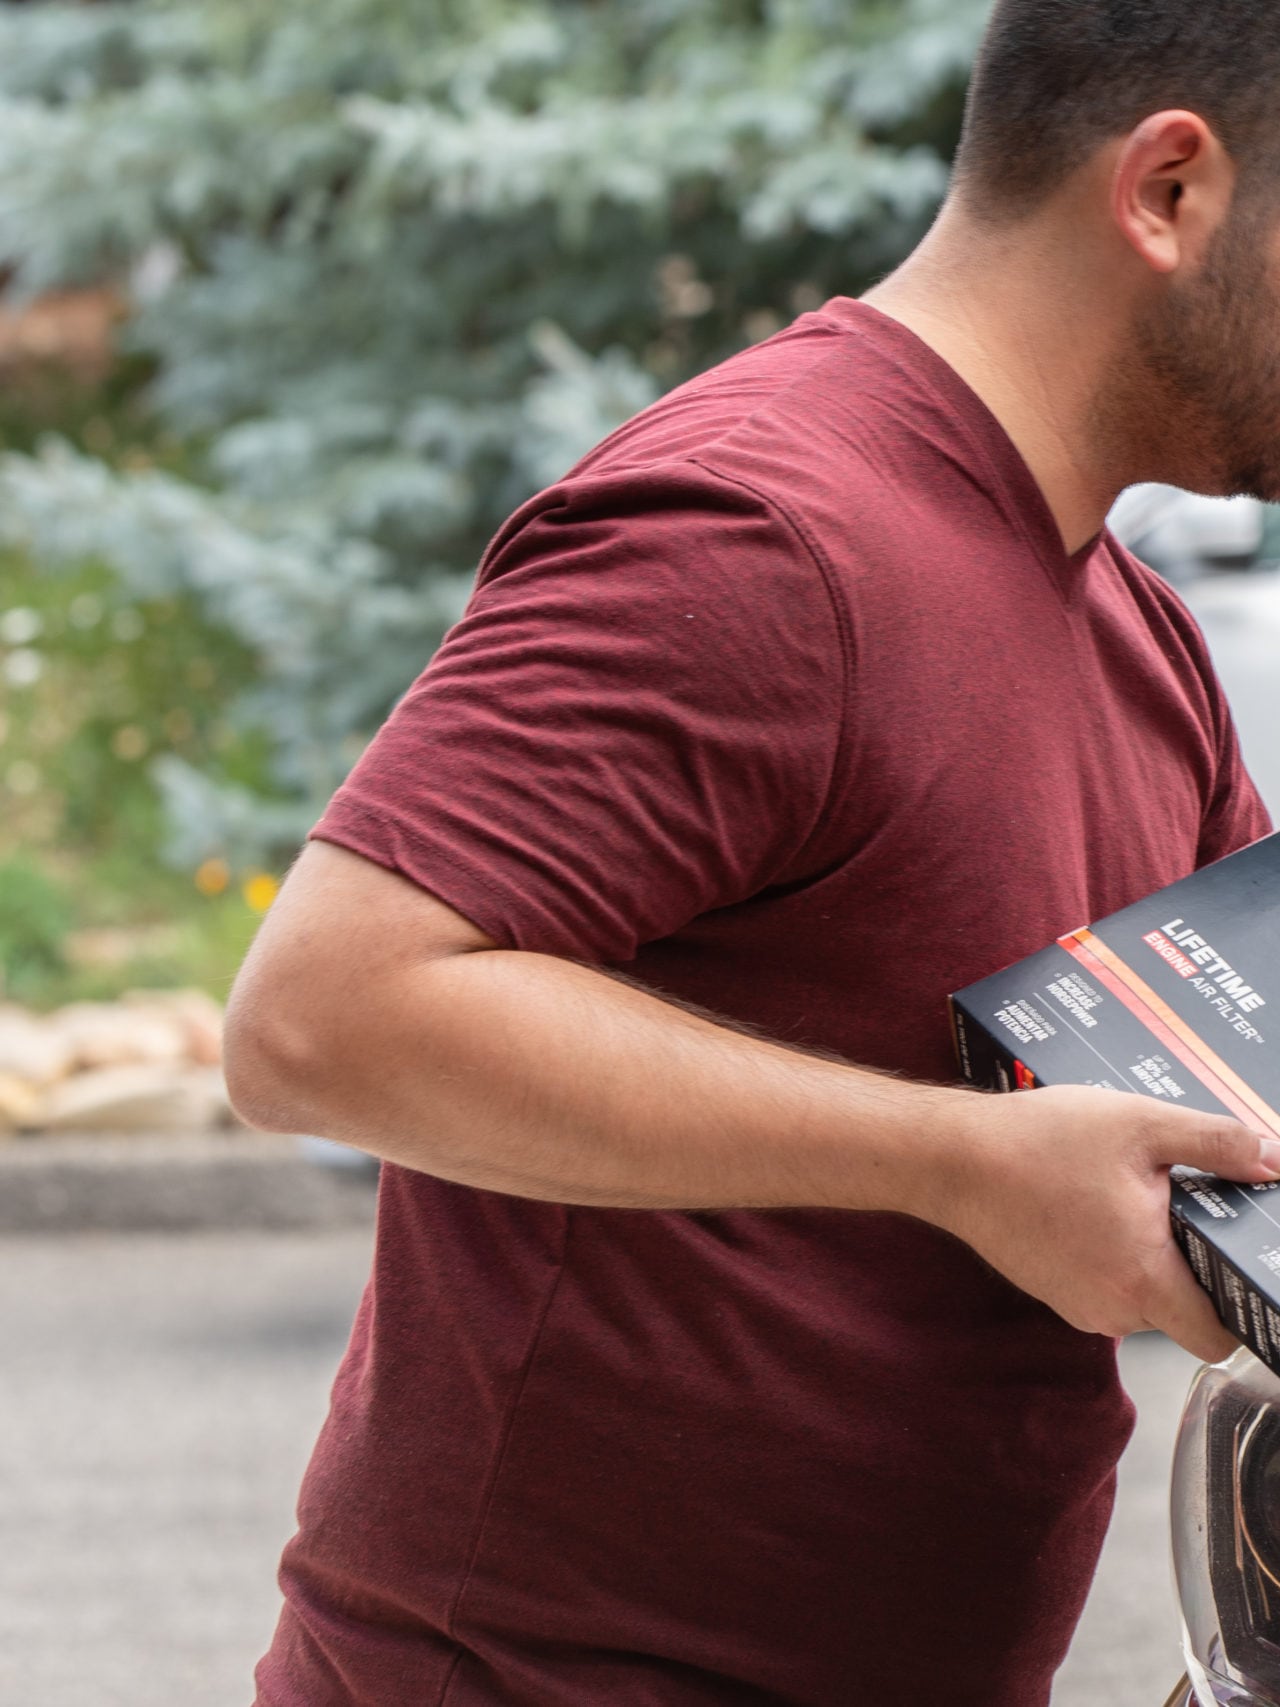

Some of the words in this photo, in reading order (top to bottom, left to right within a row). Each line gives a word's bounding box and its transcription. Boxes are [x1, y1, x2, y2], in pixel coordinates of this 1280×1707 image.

[1143, 931, 1199, 978] ENGINE
[1188, 976, 1218, 999] AIR
[1160, 918, 1266, 1013] LIFETIME
[1045, 982, 1098, 1028] HORSEPOWER
[1057, 977, 1098, 1010] INCREASE
[993, 1010, 1033, 1044] POTENCIA
[1004, 1004, 1049, 1041] AUMENTAR
[1140, 1058, 1165, 1078] 50%
[1157, 1075, 1187, 1098] MORE
